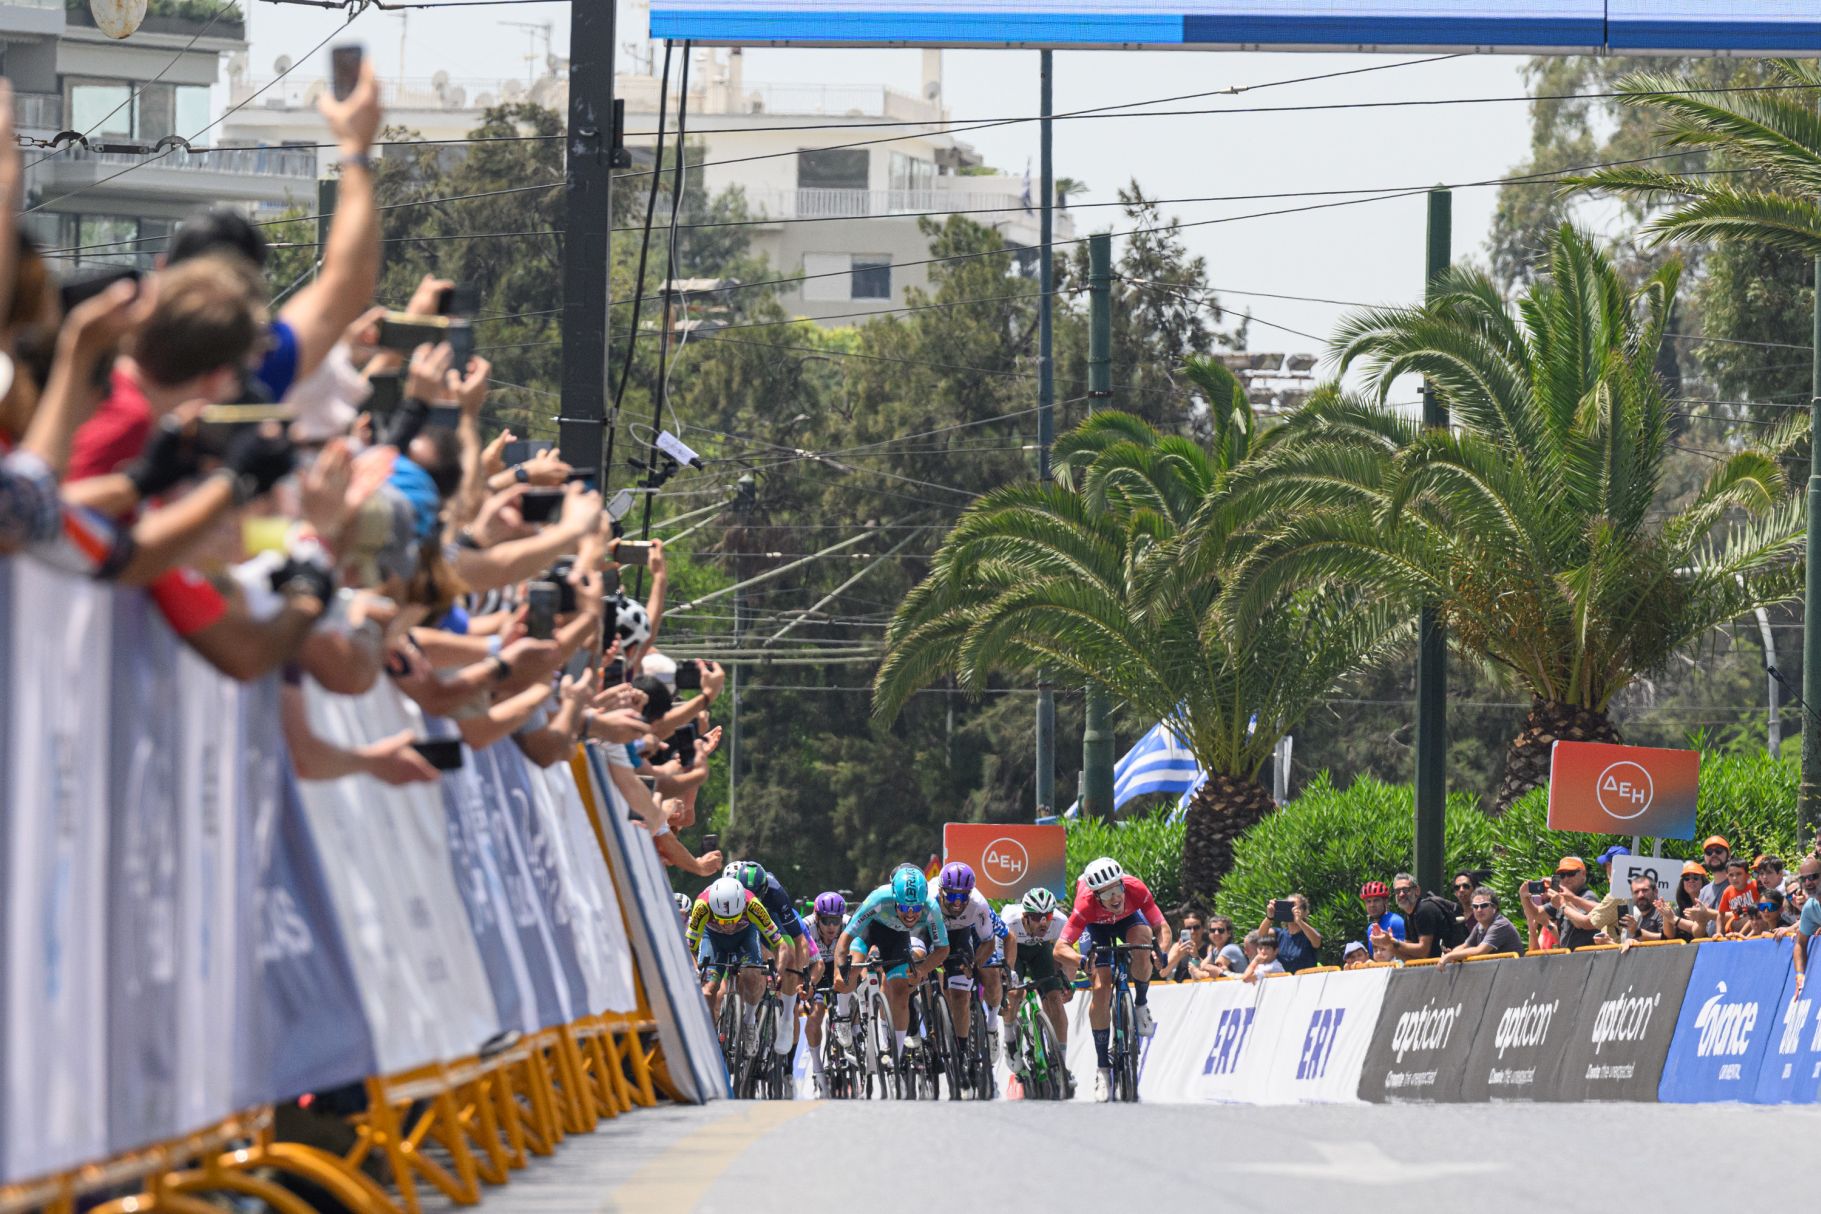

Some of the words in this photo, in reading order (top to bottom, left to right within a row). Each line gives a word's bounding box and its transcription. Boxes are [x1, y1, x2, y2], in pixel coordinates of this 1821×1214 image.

[1603, 775, 1645, 804] ΔΕΗ
[988, 850, 1022, 872] ΔΕΗ
[1202, 1006, 1256, 1075] ERT
[1295, 1007, 1346, 1080] ERT
[1391, 997, 1456, 1063] apticon
